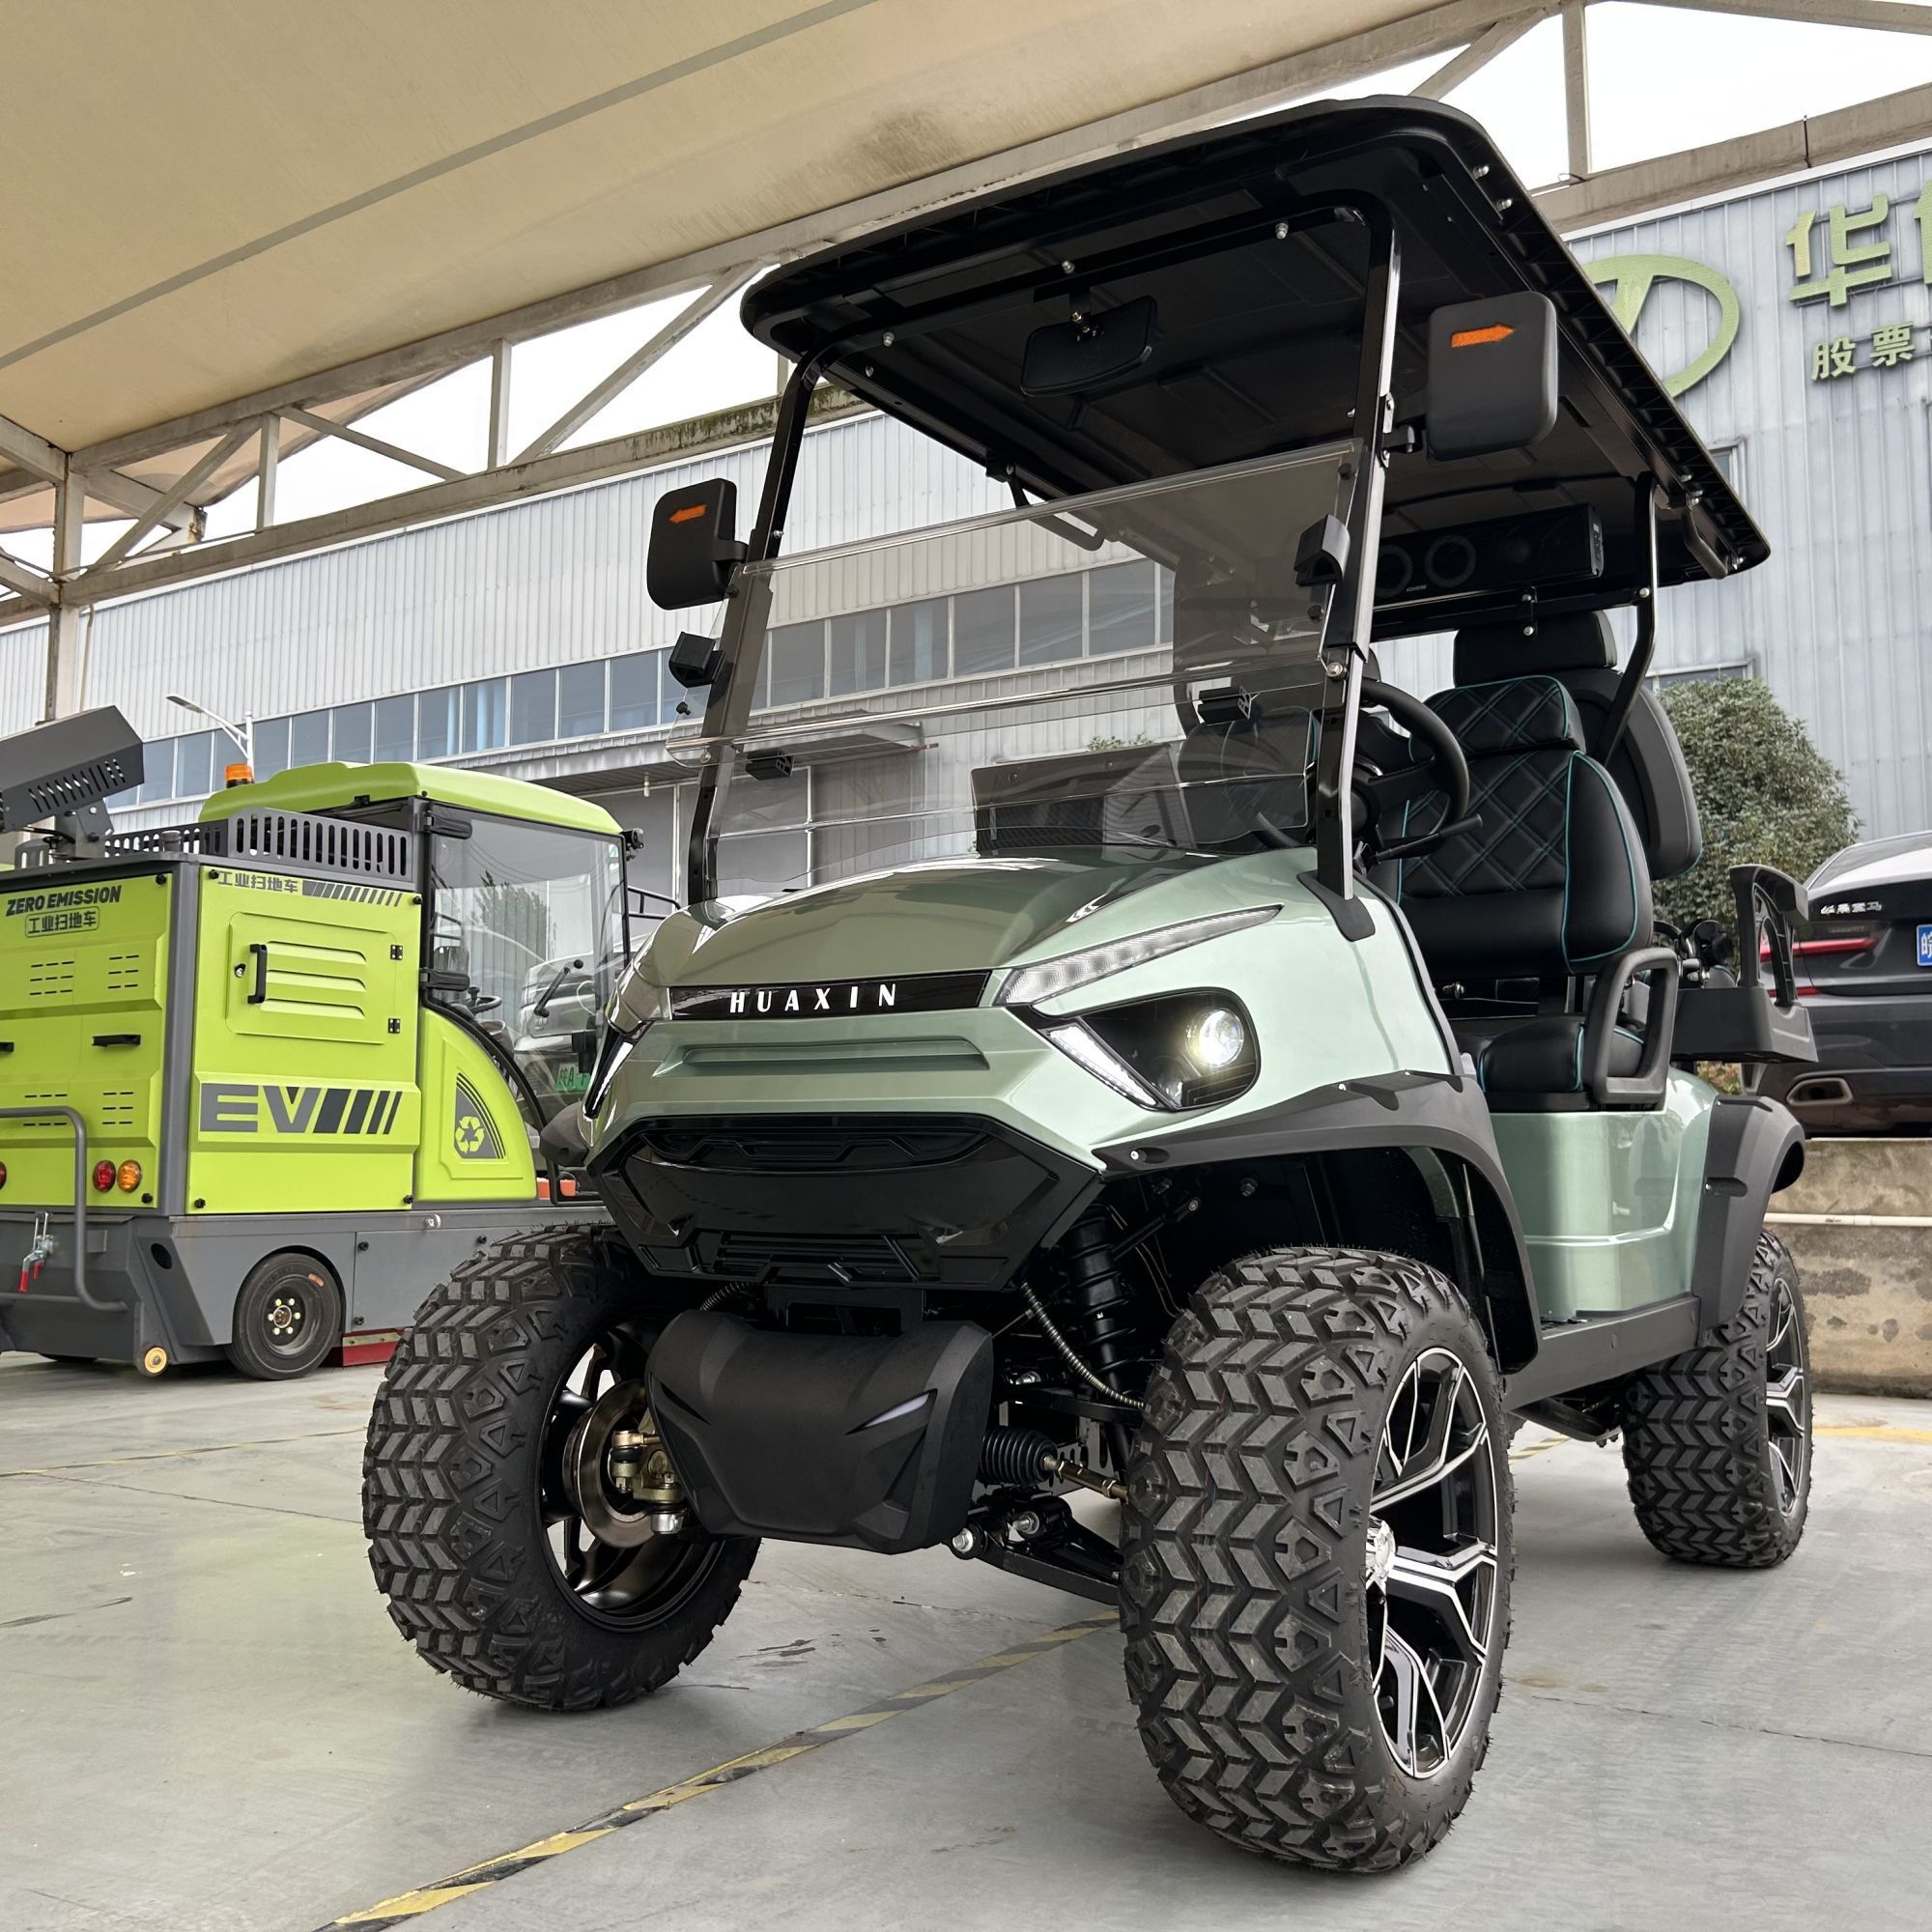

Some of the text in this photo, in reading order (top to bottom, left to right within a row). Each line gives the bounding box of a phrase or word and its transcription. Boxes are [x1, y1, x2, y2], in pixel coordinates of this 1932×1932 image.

[1786, 179, 1932, 307] 华
[1811, 321, 1932, 381] 股票
[217, 871, 298, 894] 工业扫地车
[6, 885, 122, 917] ZERO EMISSION
[28, 911, 97, 934] 工业扫地车
[729, 983, 896, 1013] HUAXIN
[200, 1083, 322, 1133] EV
